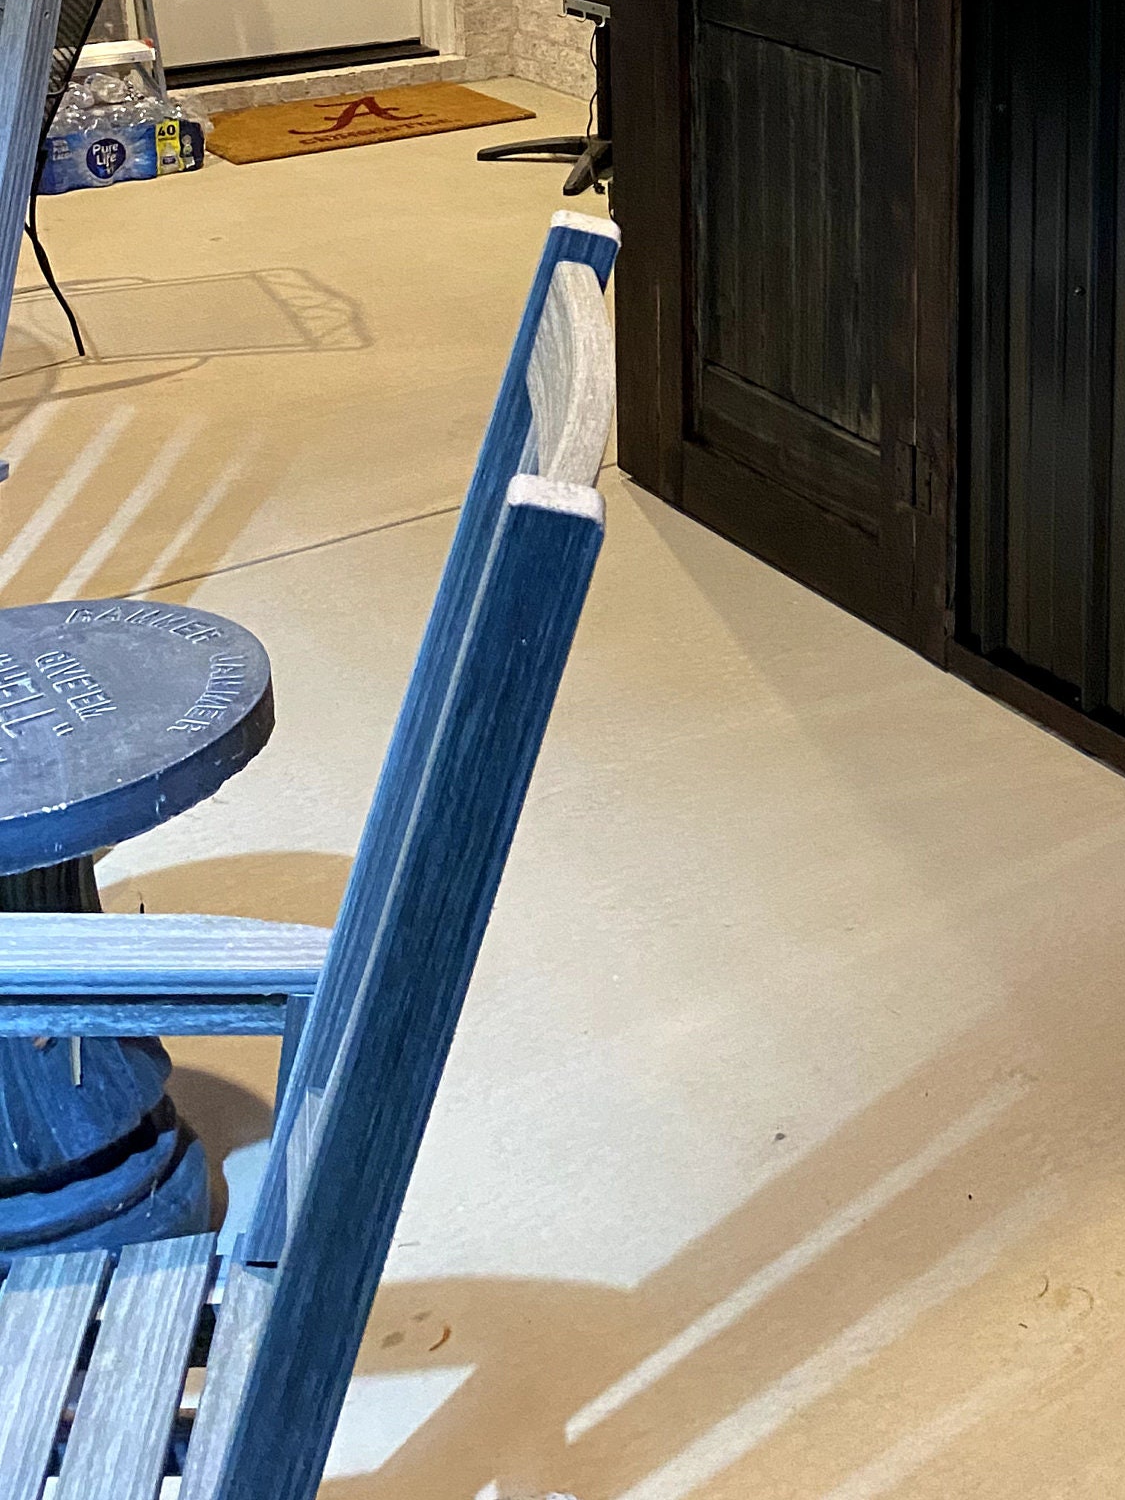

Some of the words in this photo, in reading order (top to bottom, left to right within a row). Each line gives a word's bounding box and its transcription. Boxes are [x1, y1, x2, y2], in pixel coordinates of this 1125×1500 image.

[158, 125, 176, 136] 40
[93, 142, 119, 156] Pure
[96, 153, 118, 168] Life
